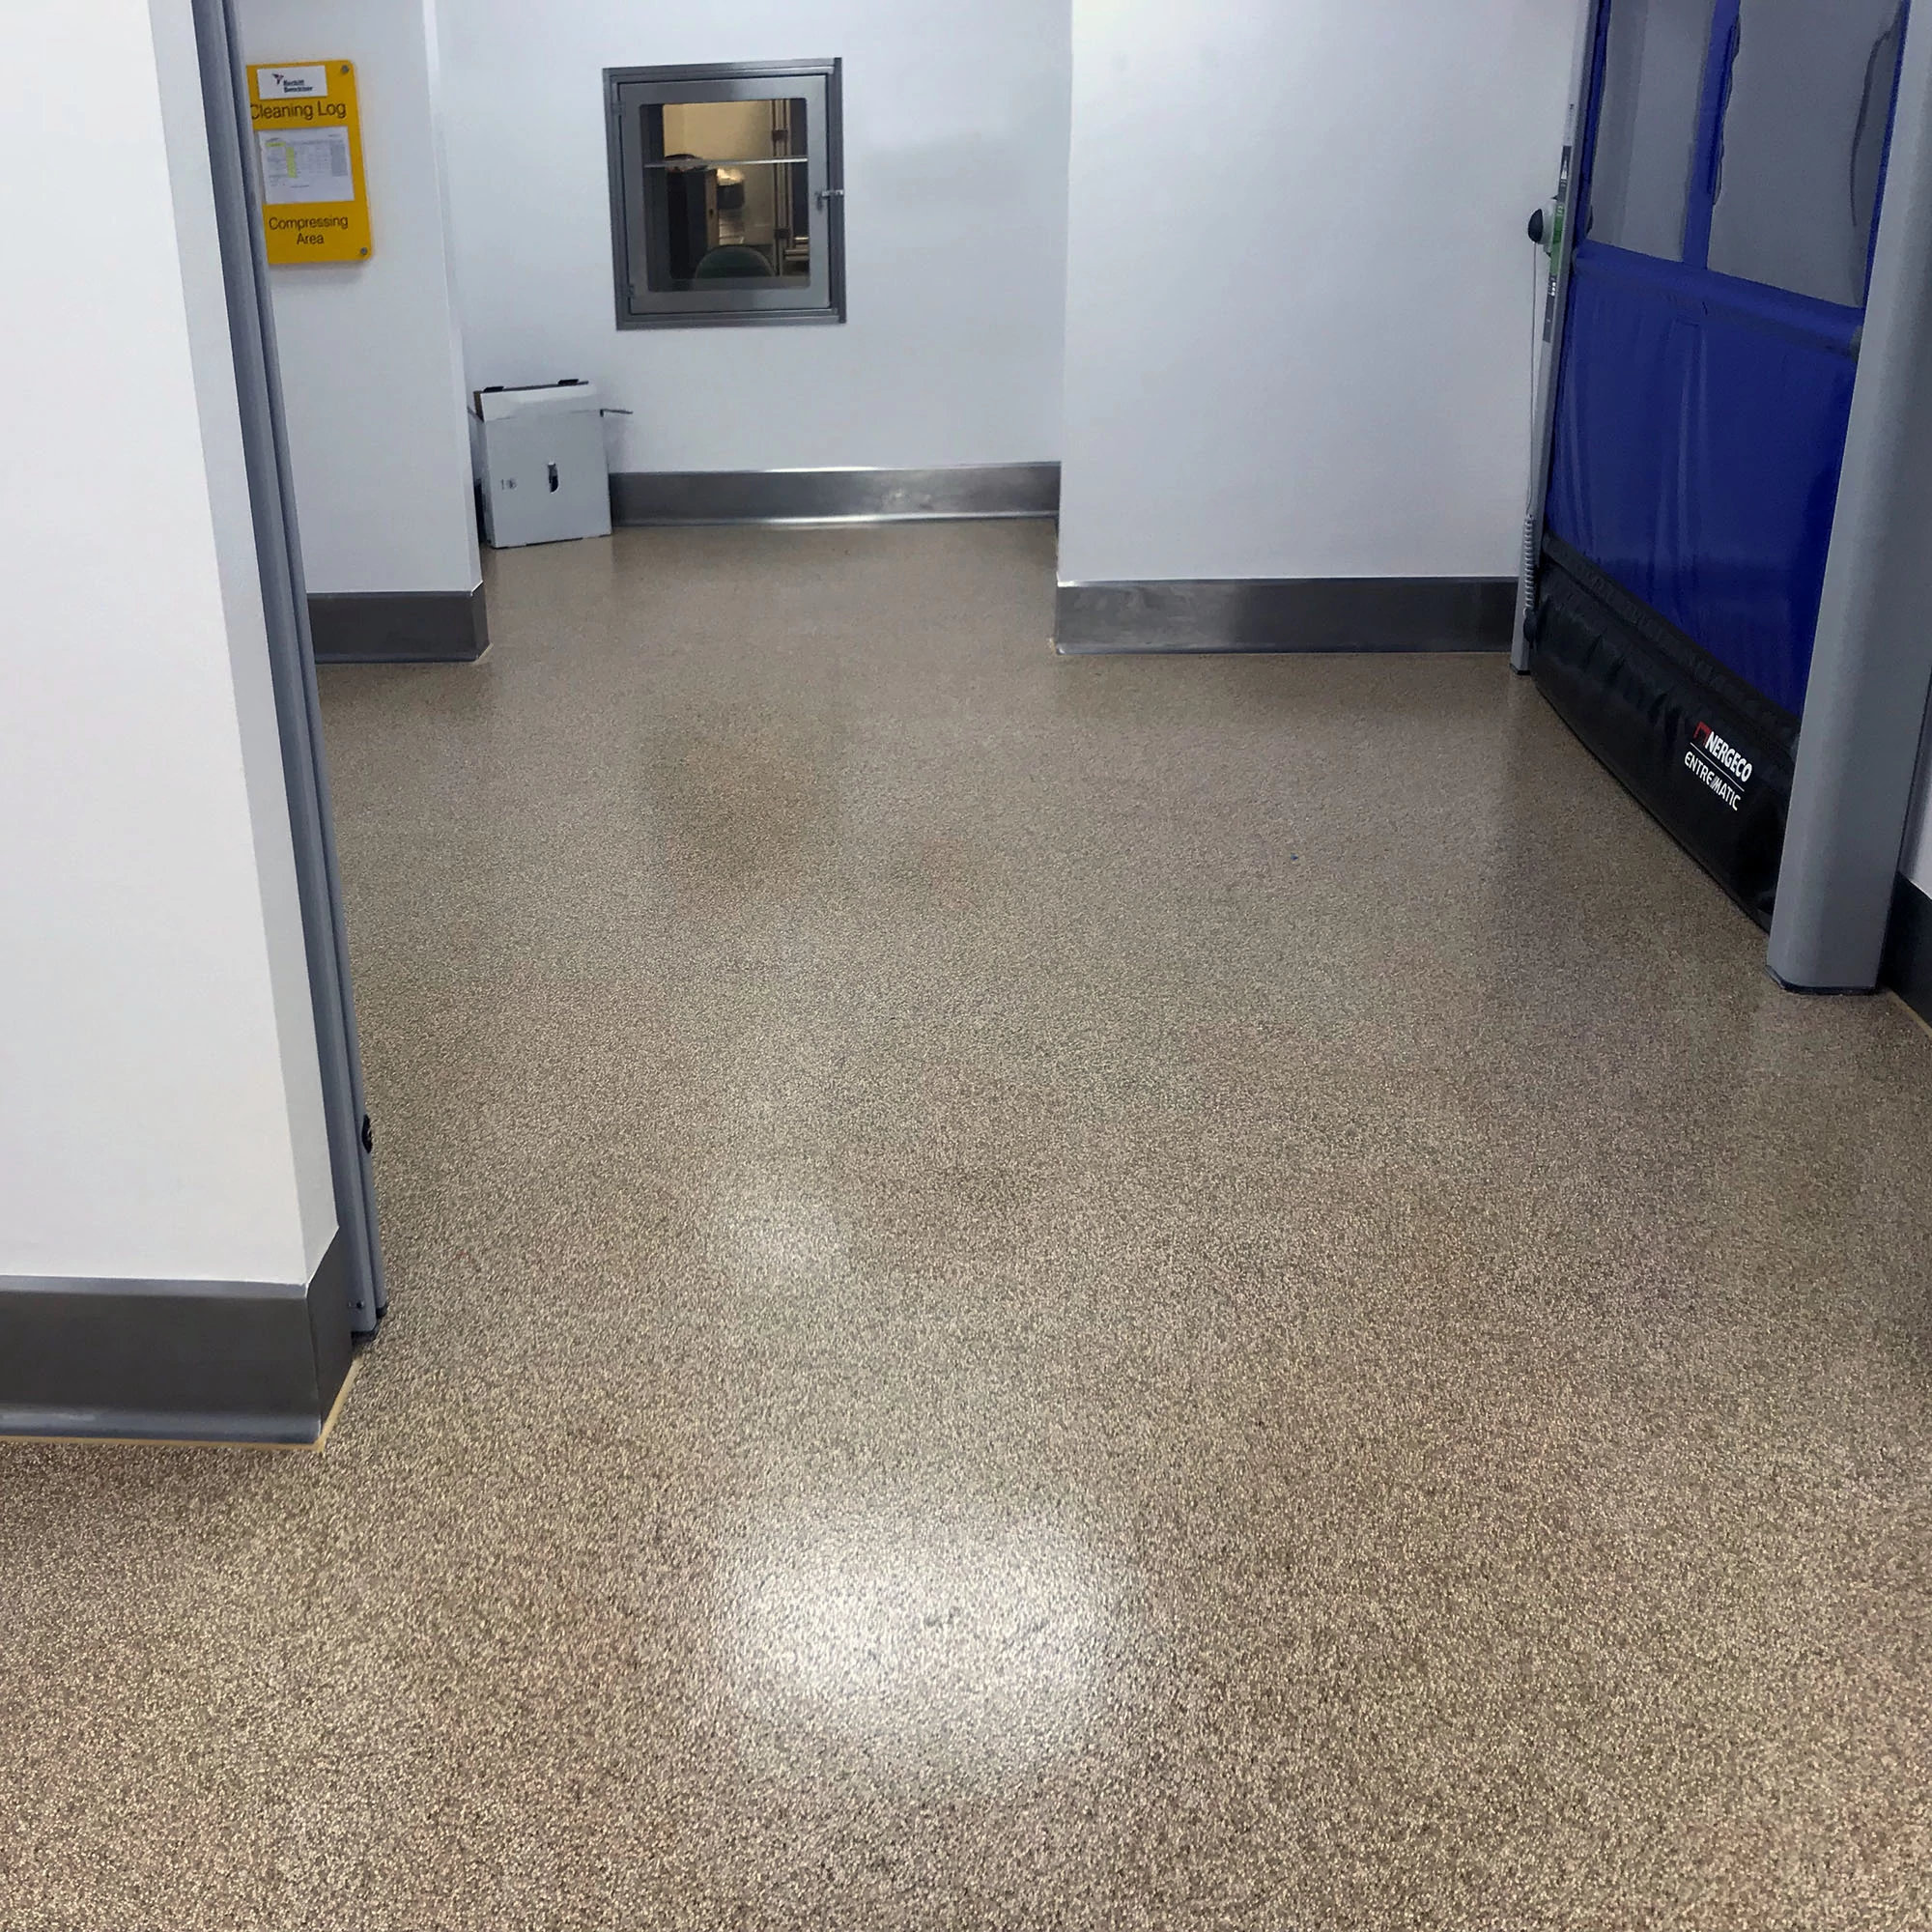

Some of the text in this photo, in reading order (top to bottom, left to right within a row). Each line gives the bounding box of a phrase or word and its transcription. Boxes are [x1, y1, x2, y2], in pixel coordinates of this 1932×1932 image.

[250, 99, 347, 121] Cleaning Log
[269, 215, 348, 230] Compressing
[296, 233, 324, 245] Area
[1704, 730, 1753, 782] NERGECO
